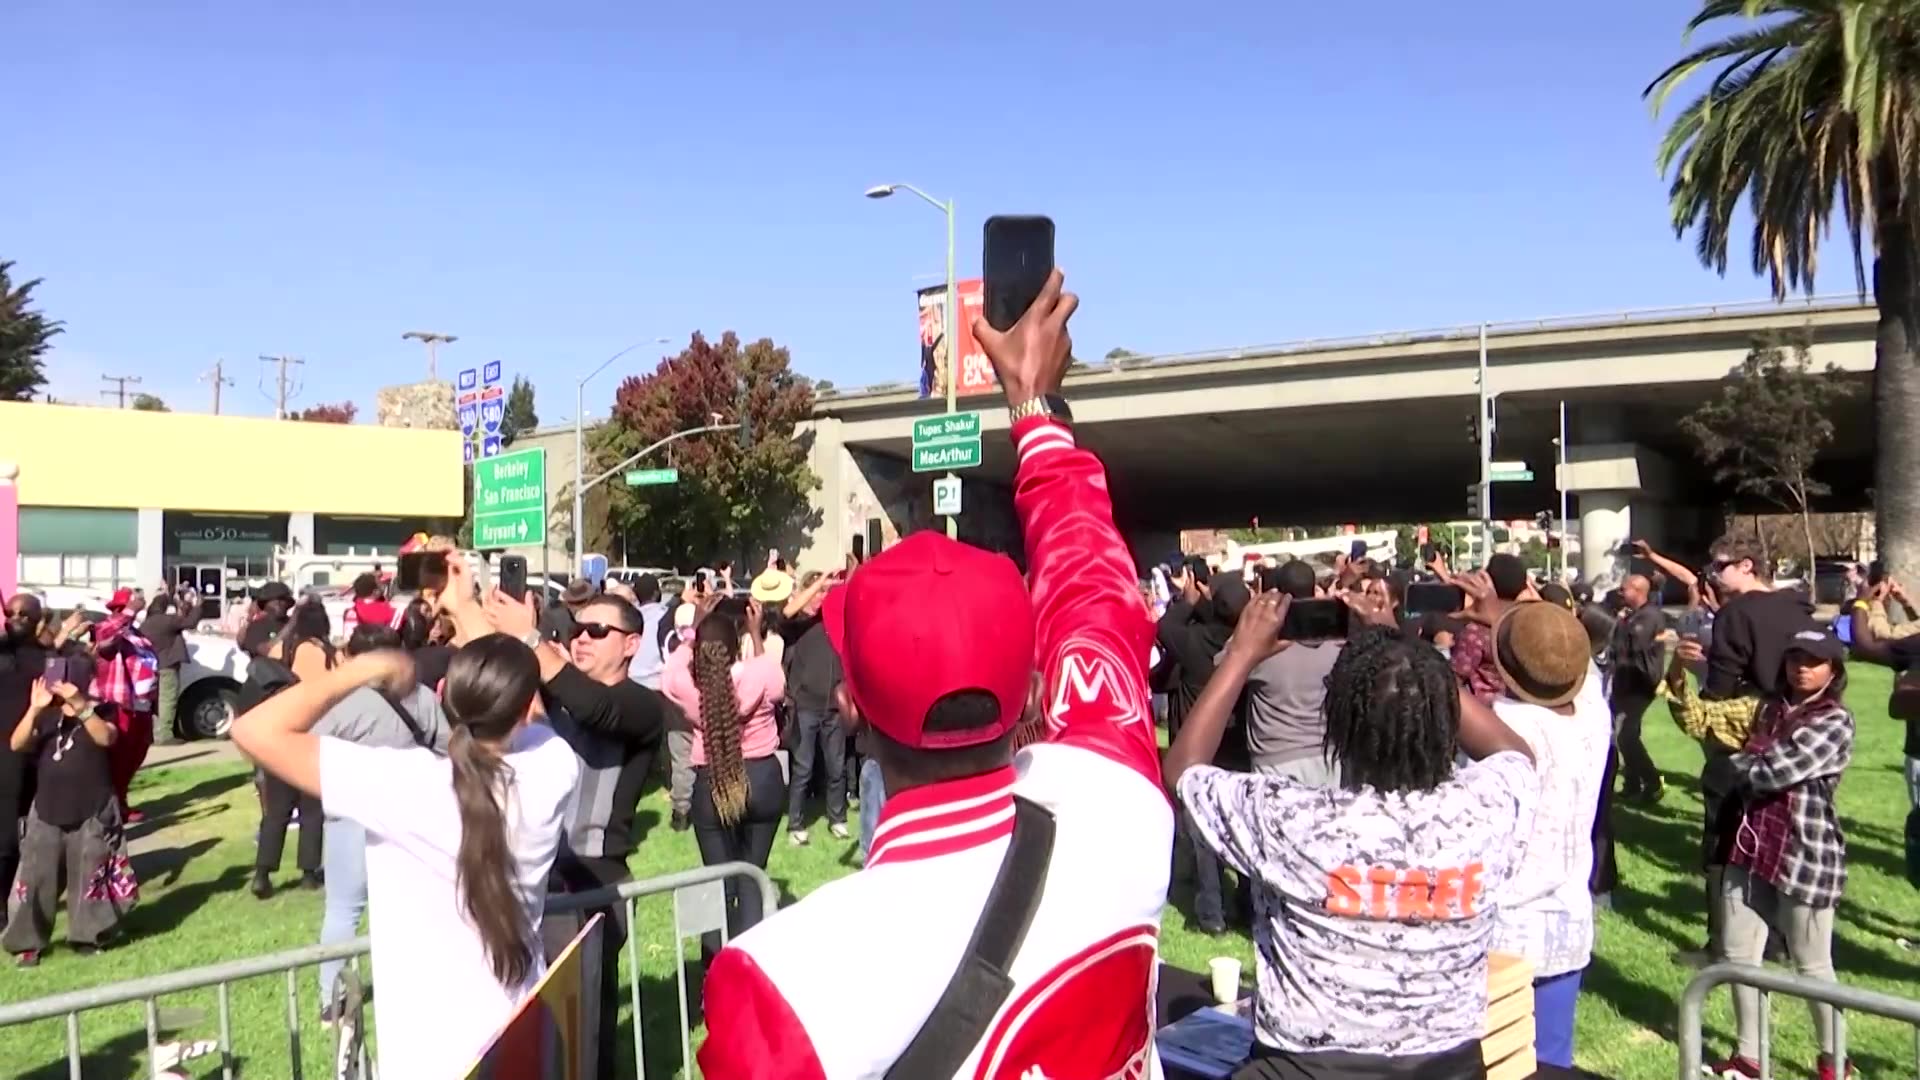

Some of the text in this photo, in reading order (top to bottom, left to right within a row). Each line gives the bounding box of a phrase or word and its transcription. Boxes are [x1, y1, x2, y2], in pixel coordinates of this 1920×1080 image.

[460, 409, 475, 426] 580
[483, 404, 501, 422] 580
[918, 419, 975, 436] Tupac Shakur
[920, 447, 973, 465] MacArthur
[494, 460, 528, 481] Berkeley
[484, 483, 540, 505] San Francisco
[204, 526, 237, 542] 650
[482, 521, 517, 545] Hayward
[1327, 862, 1483, 918] STAFF
